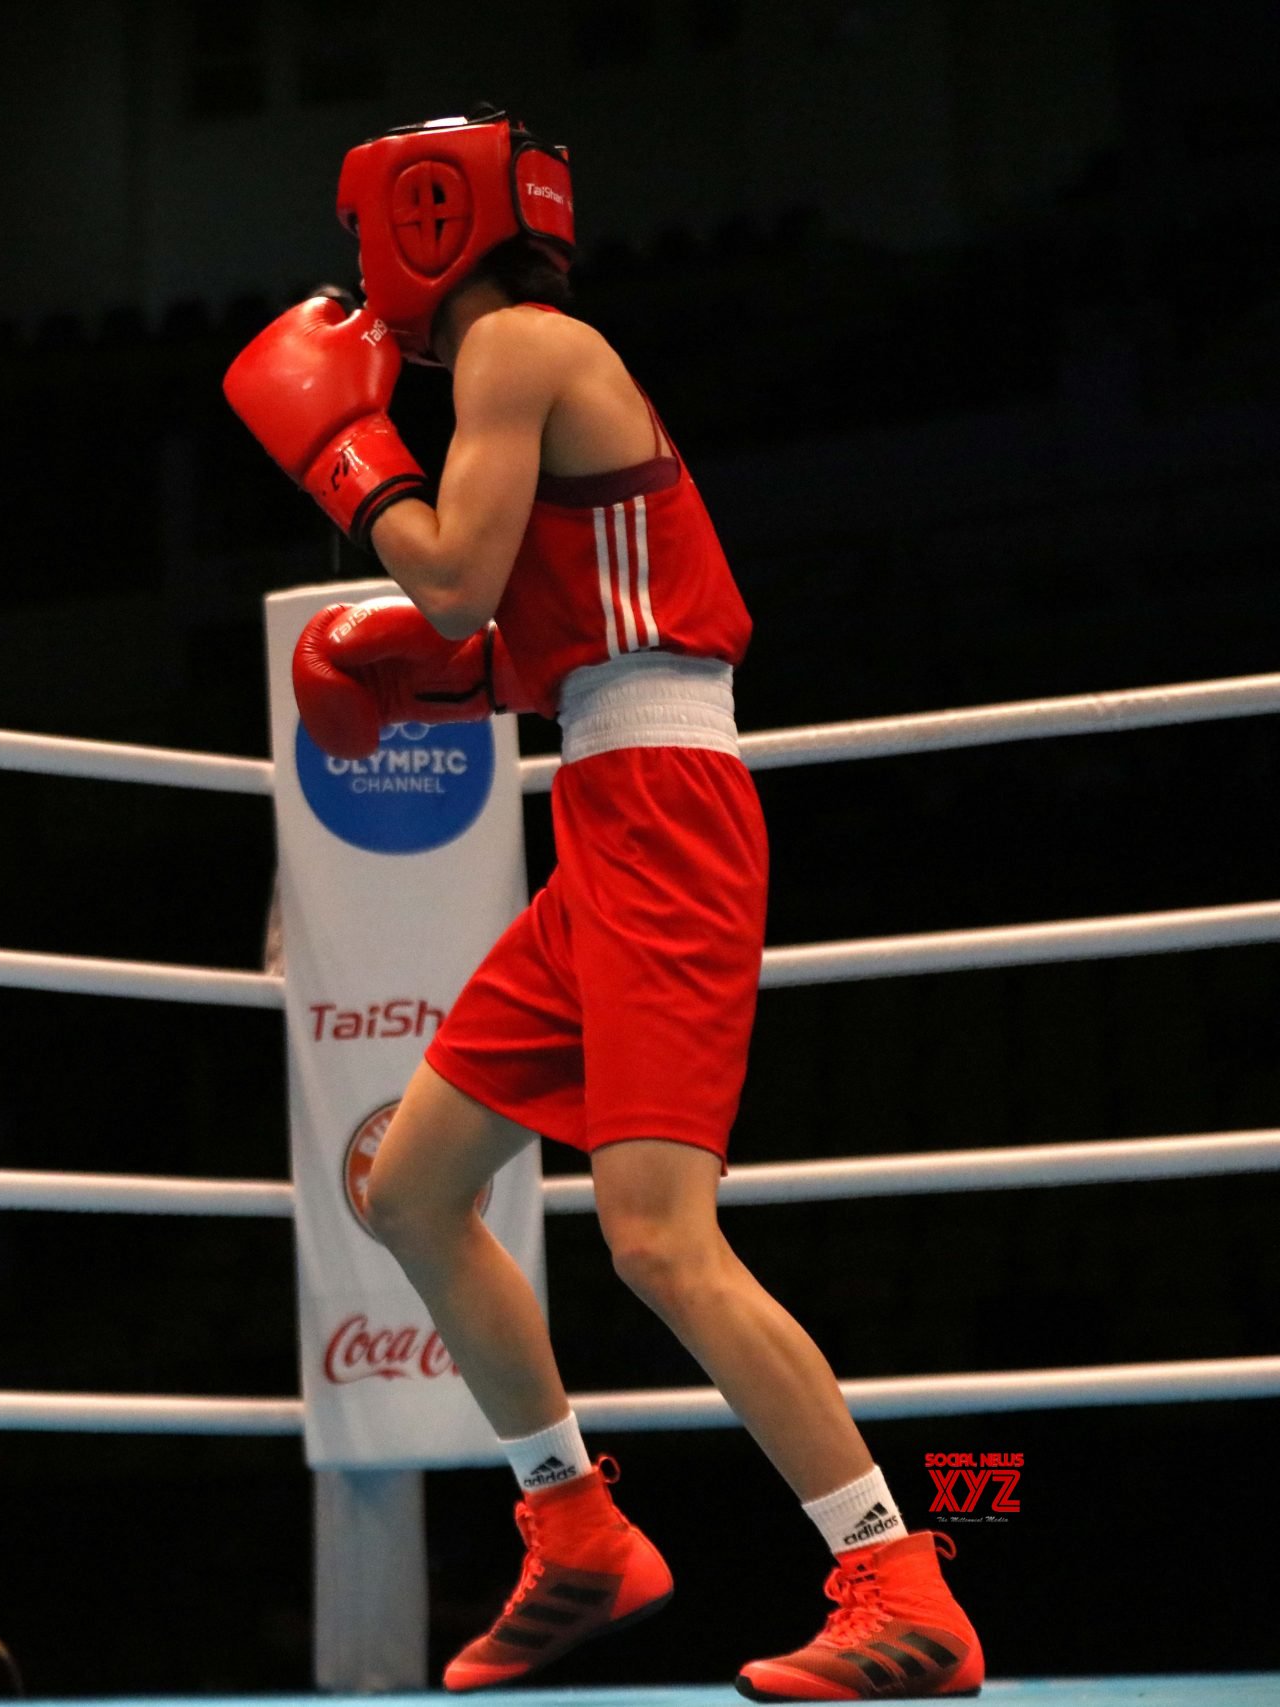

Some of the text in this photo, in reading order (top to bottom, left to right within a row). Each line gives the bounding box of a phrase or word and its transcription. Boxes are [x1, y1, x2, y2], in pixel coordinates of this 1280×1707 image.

[327, 749, 468, 775] OLYMPIC
[351, 776, 445, 794] CHANNEL
[323, 1313, 419, 1384] Coca
[523, 1465, 577, 1488] adidas
[843, 1515, 899, 1546] adidas
